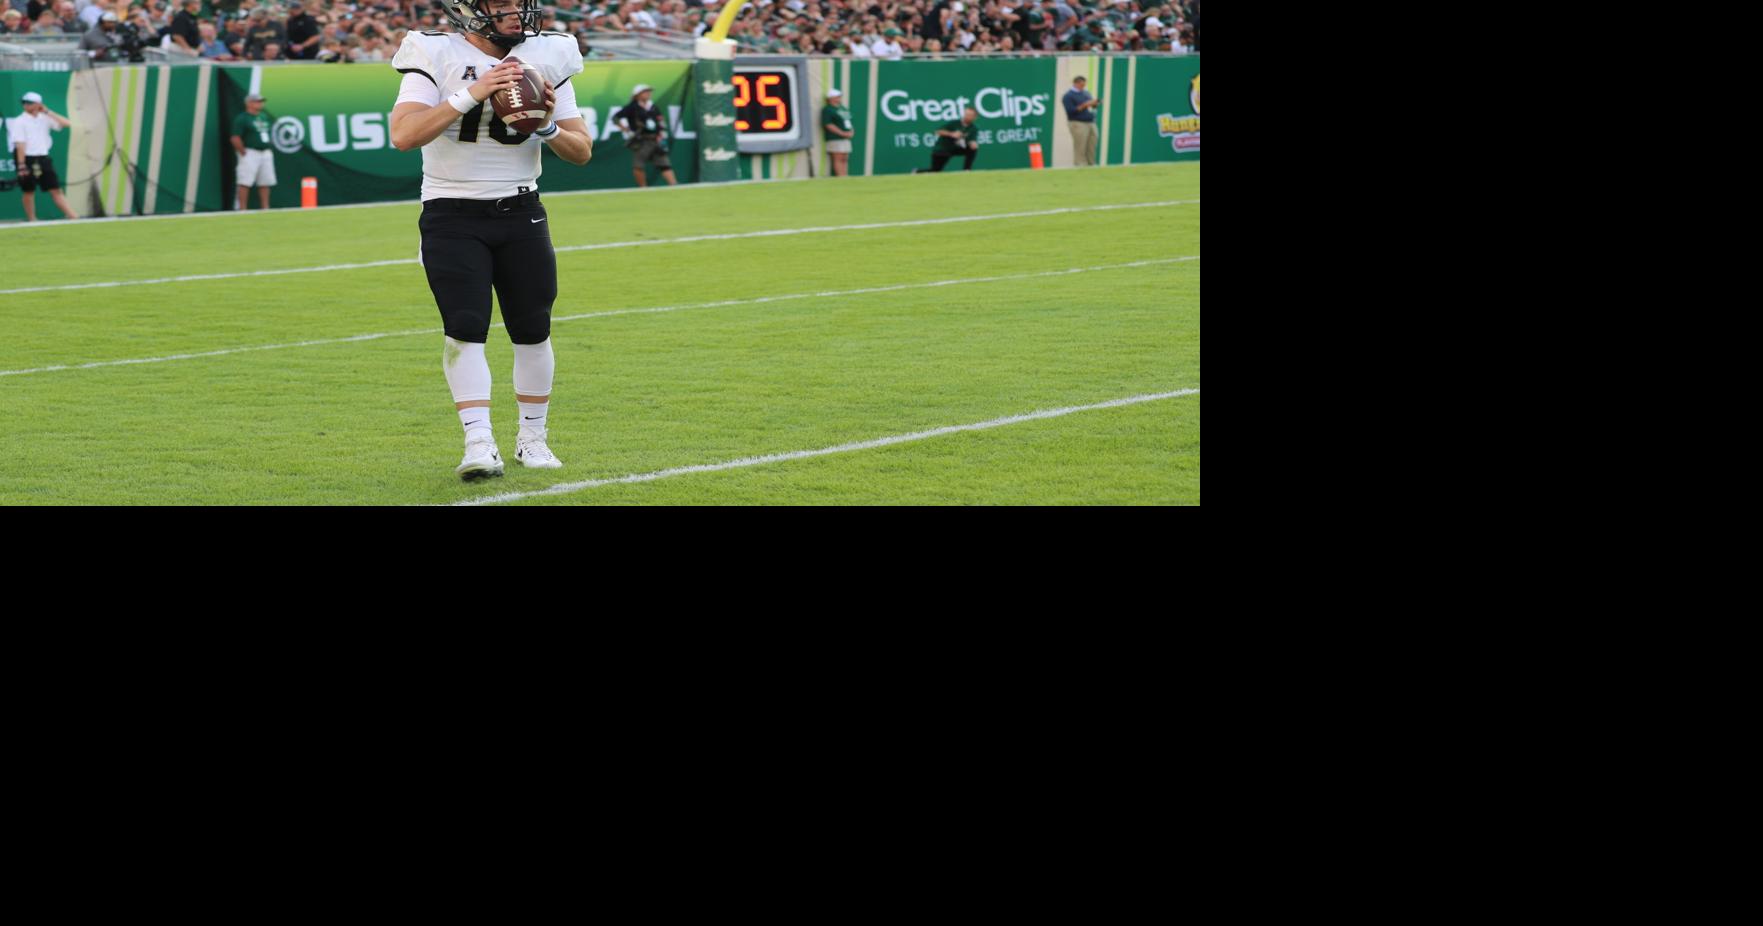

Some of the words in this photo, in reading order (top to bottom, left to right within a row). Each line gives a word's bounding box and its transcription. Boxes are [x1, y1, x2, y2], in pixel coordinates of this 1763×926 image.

[731, 75, 787, 131] 25
[880, 89, 969, 122] Great
[894, 132, 920, 148] IT'S
